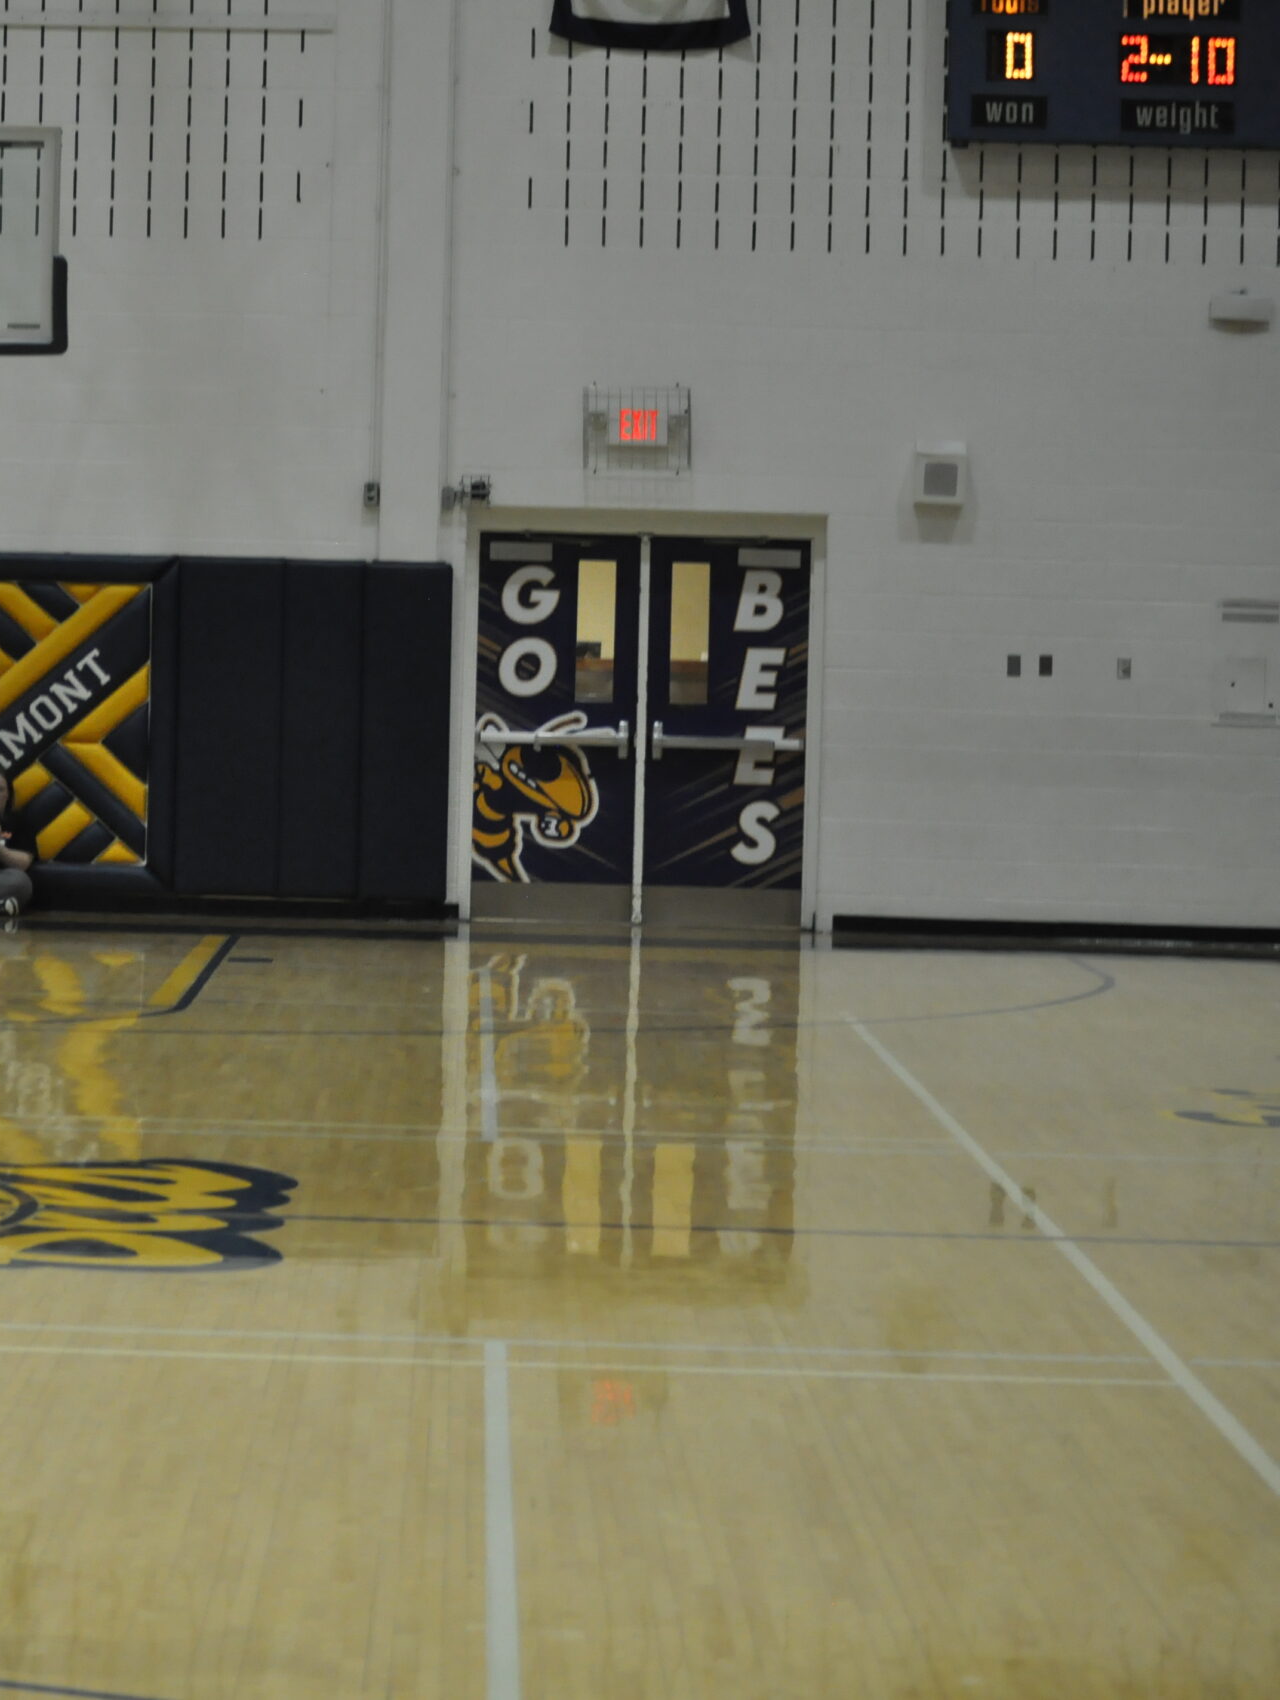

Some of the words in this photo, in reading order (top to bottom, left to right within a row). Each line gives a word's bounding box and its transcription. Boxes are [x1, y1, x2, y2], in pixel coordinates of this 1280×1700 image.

[1005, 31, 1033, 80] 0
[985, 102, 1034, 123] won
[1136, 101, 1220, 134] weight
[619, 408, 659, 440] EXIT
[498, 565, 561, 698] GO
[730, 569, 787, 866] BEES
